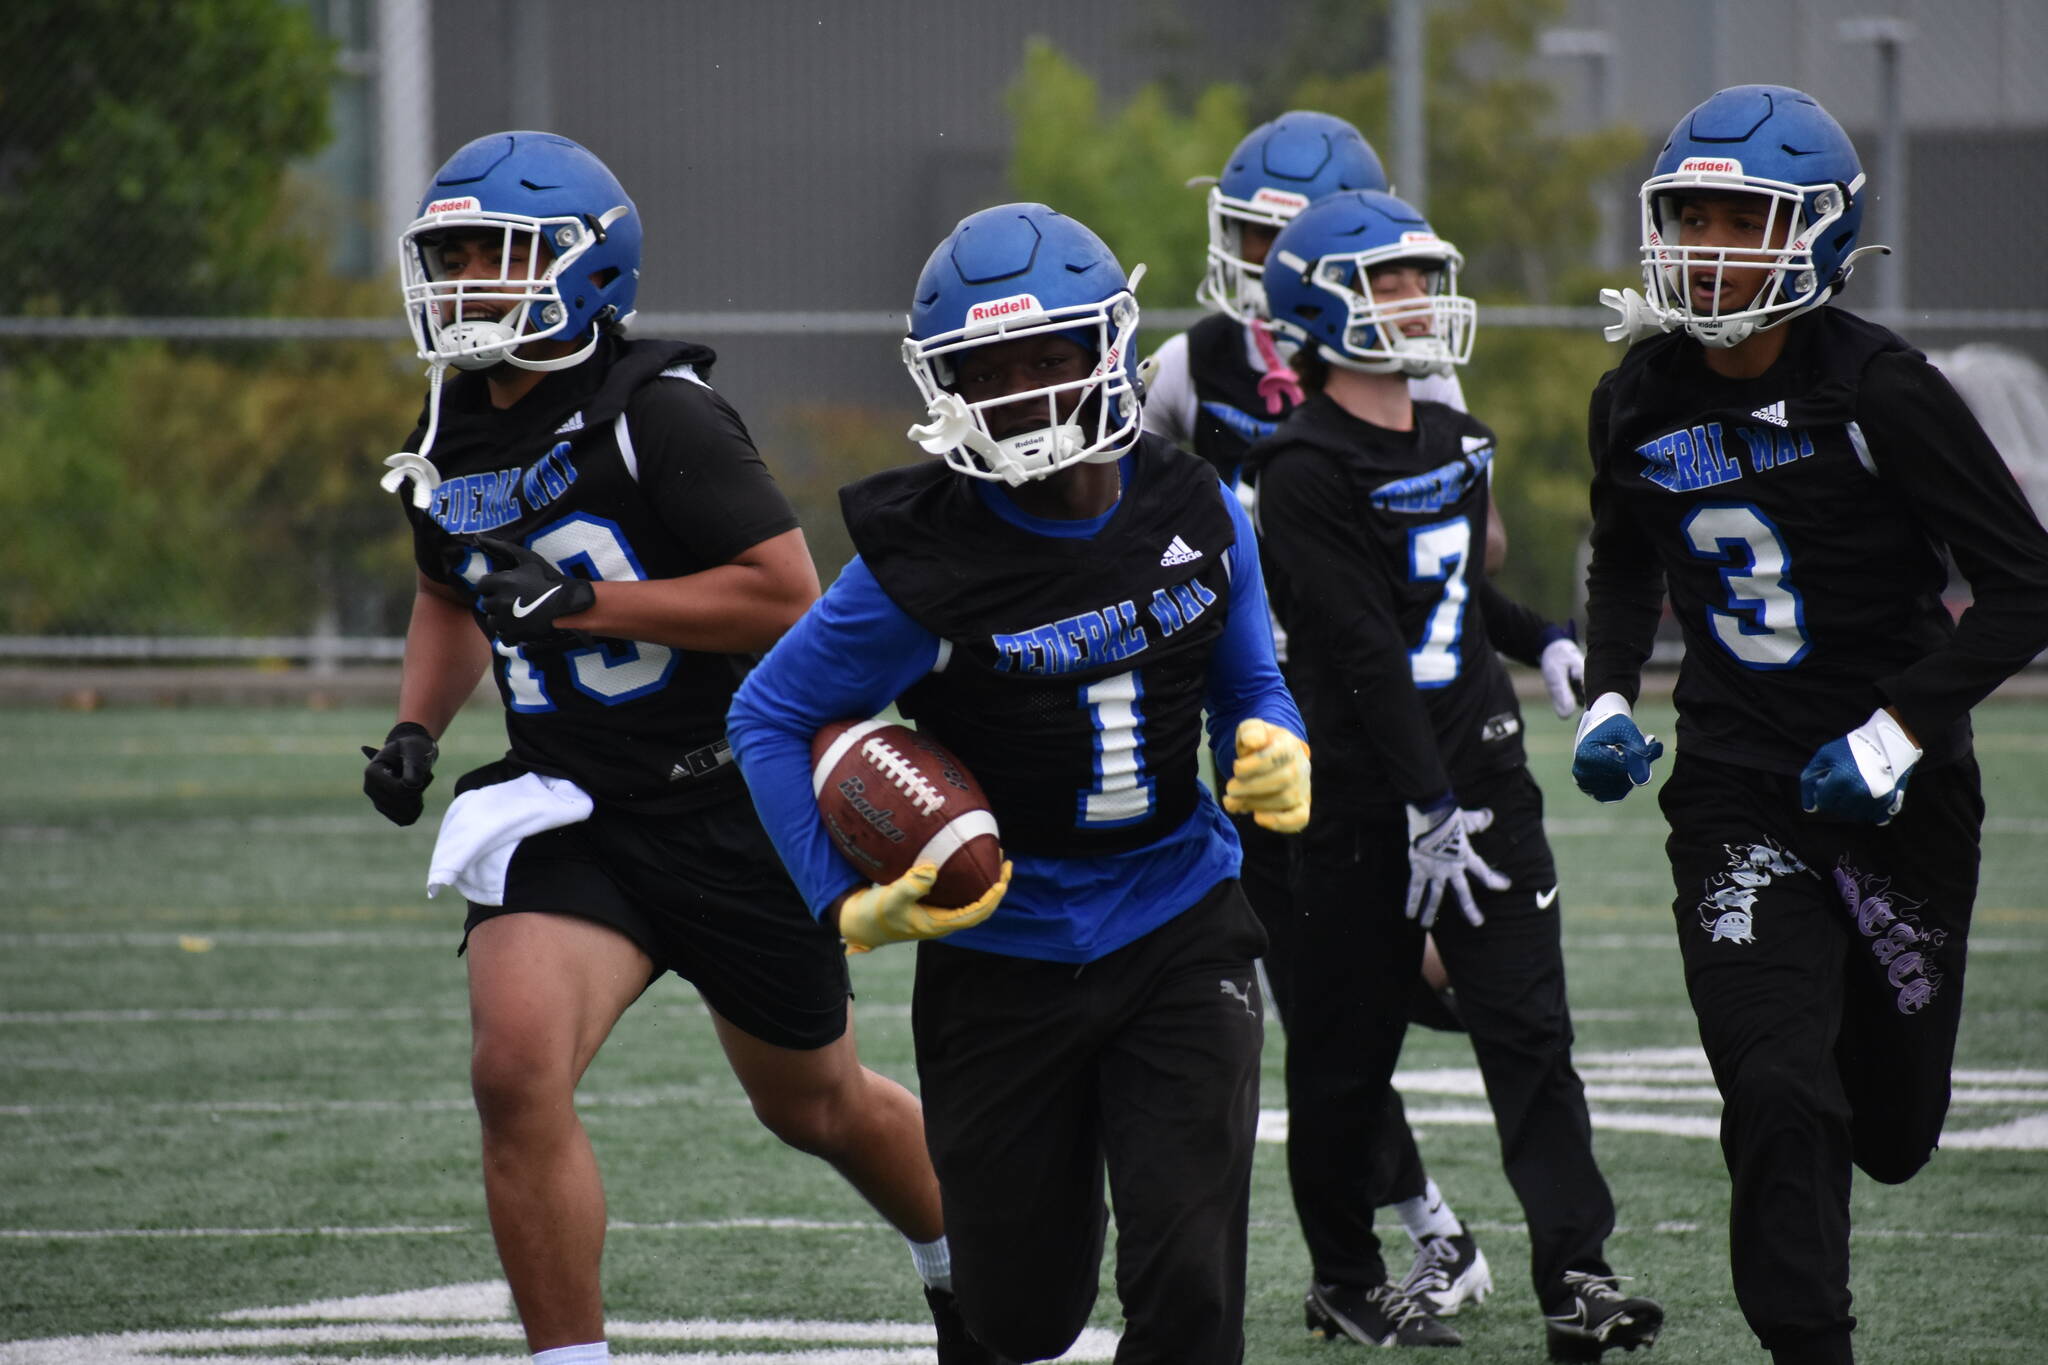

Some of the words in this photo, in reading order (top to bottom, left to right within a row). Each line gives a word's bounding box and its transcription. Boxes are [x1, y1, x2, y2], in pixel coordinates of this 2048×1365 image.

[428, 199, 472, 214] Riddell
[972, 297, 1032, 321] Riddell
[1014, 436, 1045, 449] Riddell
[1751, 409, 1789, 428] adidas
[428, 467, 522, 535] EDERAL
[1160, 550, 1203, 567] adidas
[1680, 502, 1814, 671] 3
[1406, 515, 1471, 689] 7
[991, 599, 1149, 675] FEDERAL
[1075, 667, 1157, 829] 1
[837, 775, 906, 844] Baden
